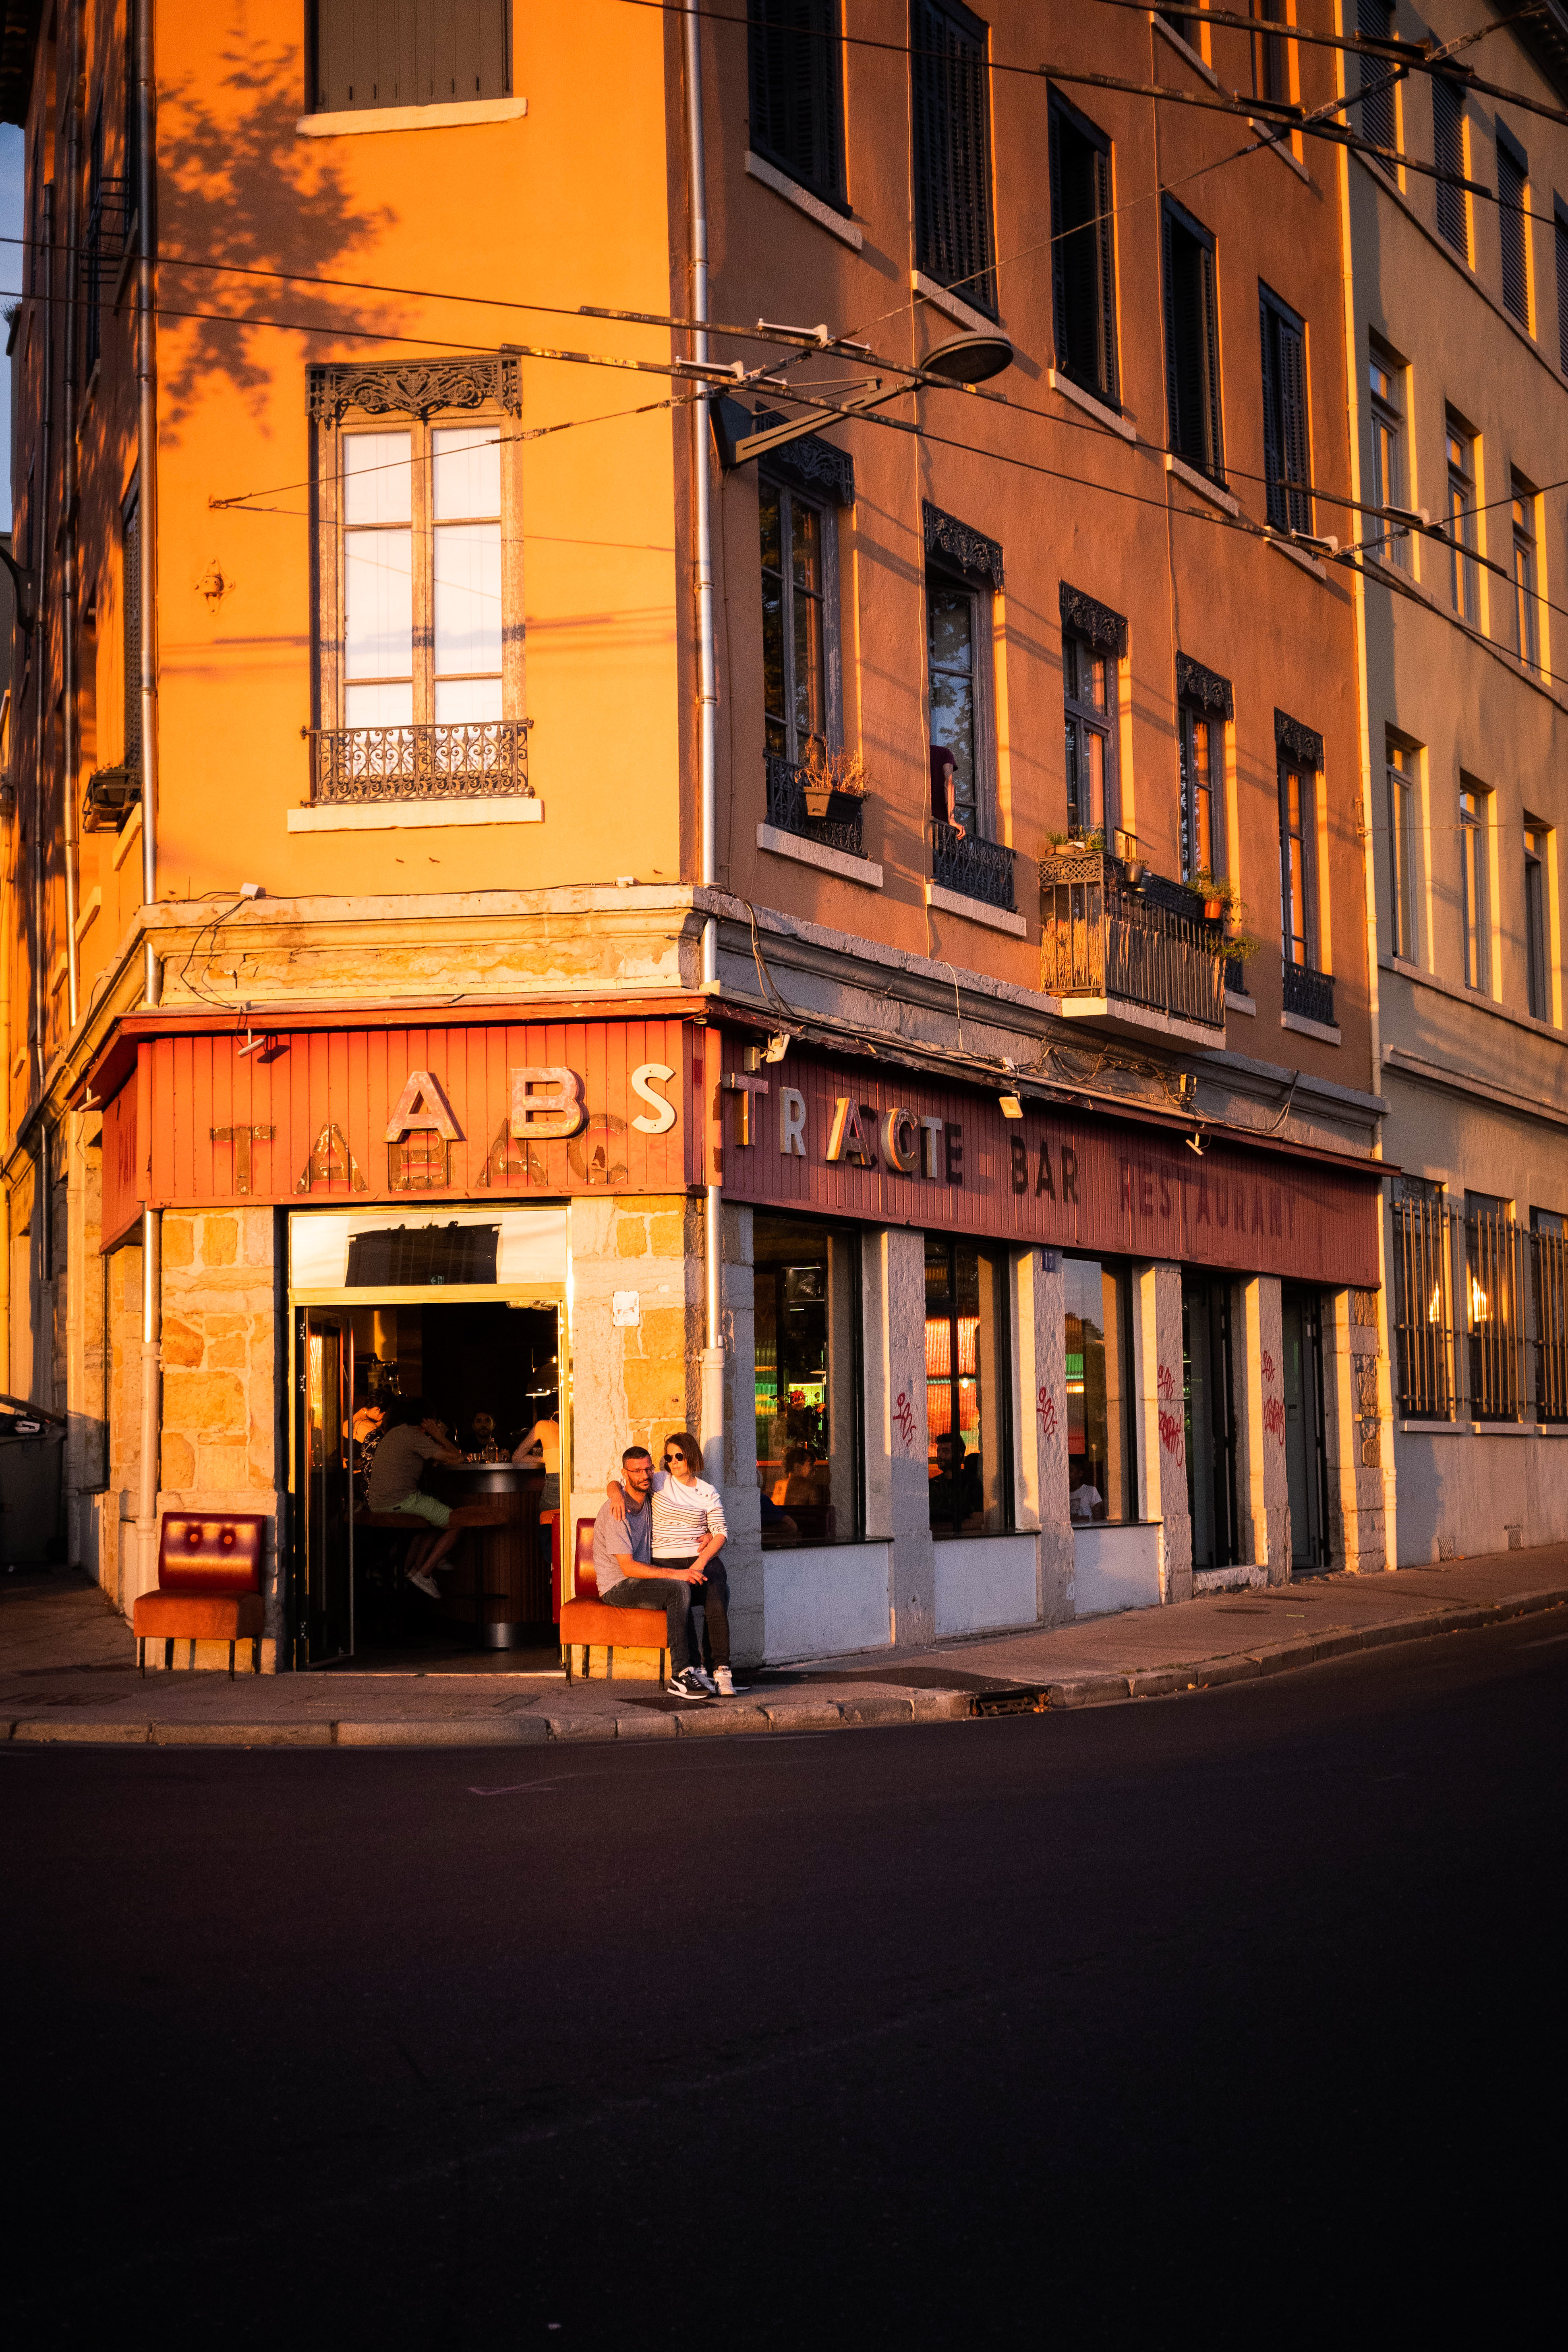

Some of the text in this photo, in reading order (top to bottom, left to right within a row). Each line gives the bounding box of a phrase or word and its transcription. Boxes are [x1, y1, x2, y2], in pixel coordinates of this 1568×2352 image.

[209, 1112, 628, 1196] TABAC
[1010, 1134, 1079, 1207] BAR
[1044, 1251, 1053, 1269] 17
